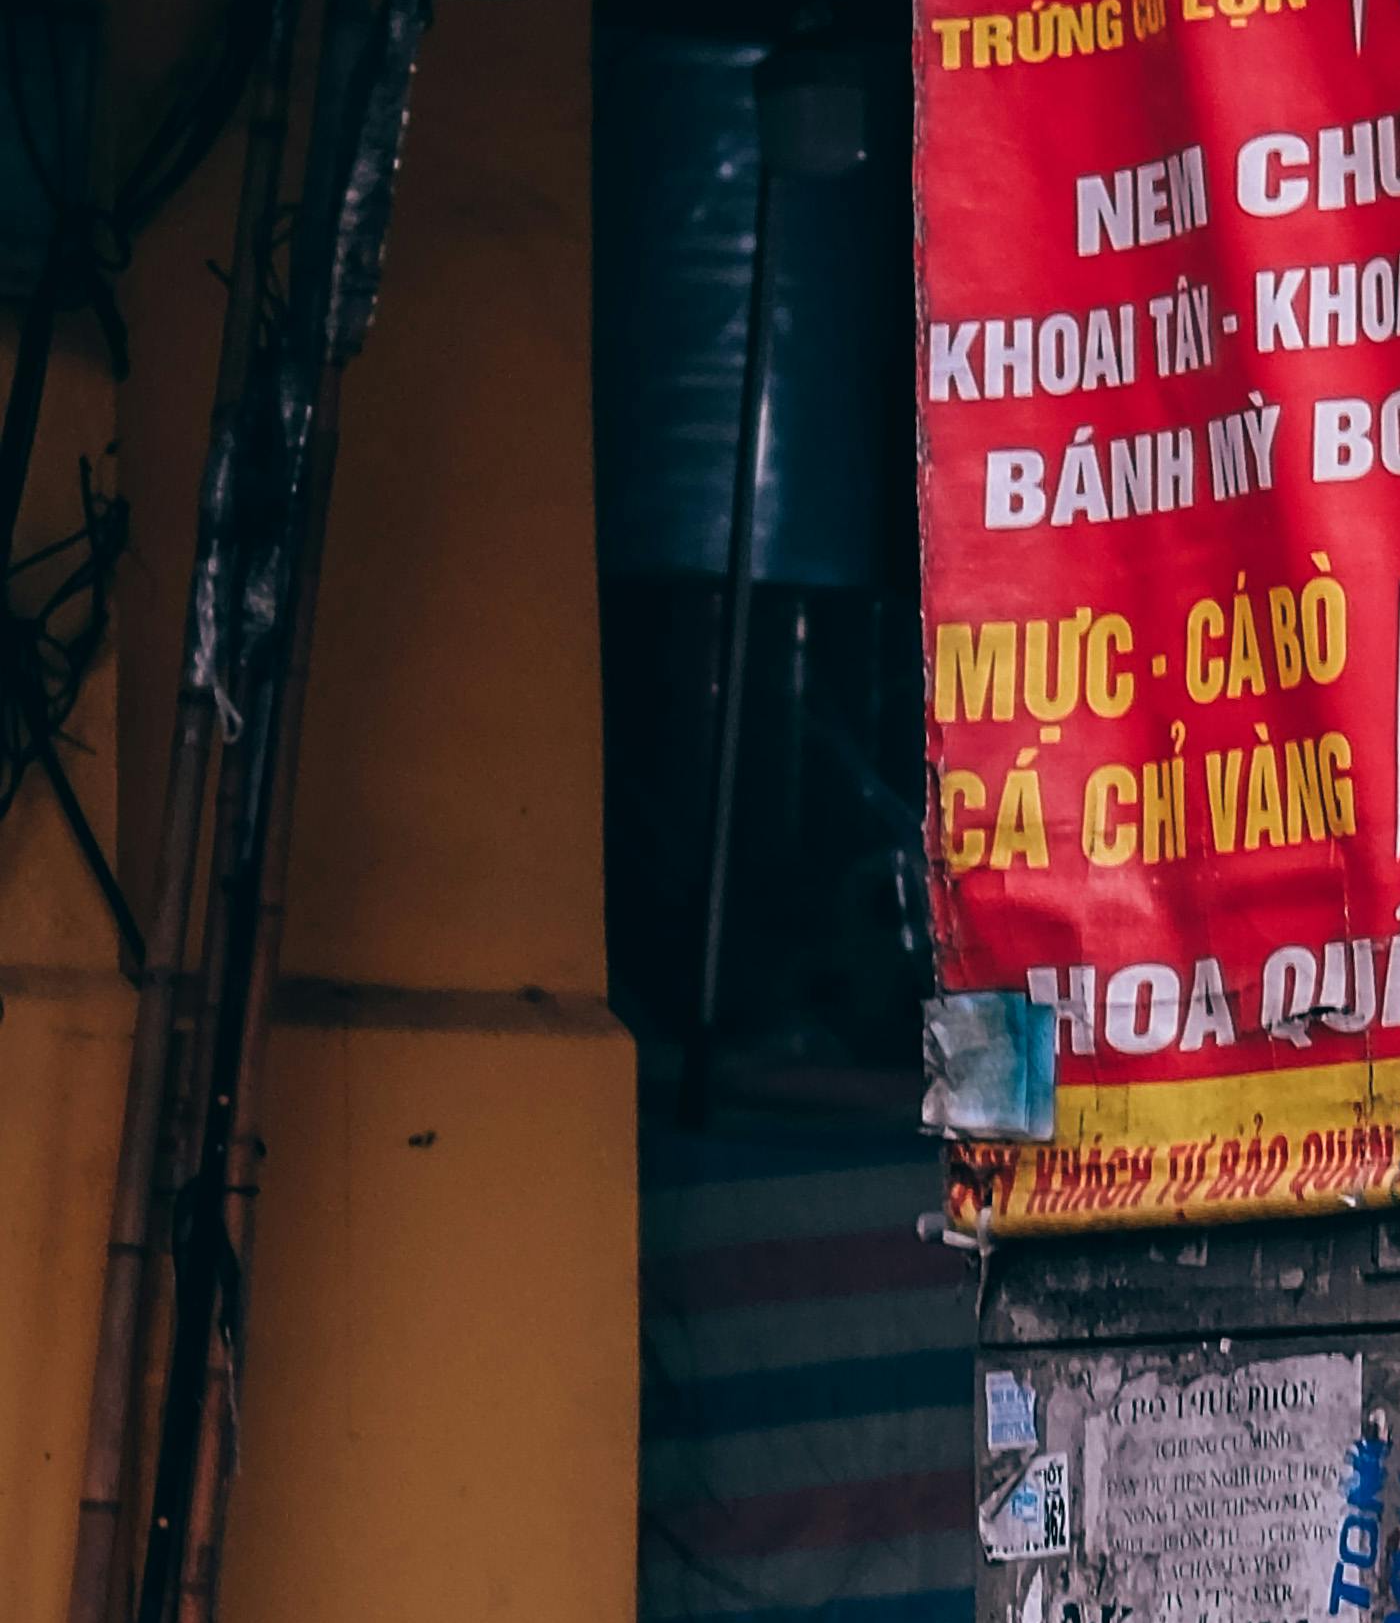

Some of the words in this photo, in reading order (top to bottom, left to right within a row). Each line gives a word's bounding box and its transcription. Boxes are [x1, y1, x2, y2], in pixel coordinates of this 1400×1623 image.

[1075, 145, 1208, 257] NEM
[928, 303, 1136, 404] KHOAI
[1149, 274, 1215, 375] TÂY
[984, 425, 1195, 530] BÁNH
[934, 606, 1135, 743] MỰC
[1185, 572, 1267, 704] CÁ
[1271, 550, 1348, 690] BÒ
[942, 750, 1049, 874] CÁ
[1080, 721, 1189, 868] CHỈ
[1204, 723, 1356, 854] VÀNG
[1027, 954, 1239, 1058] HOA
